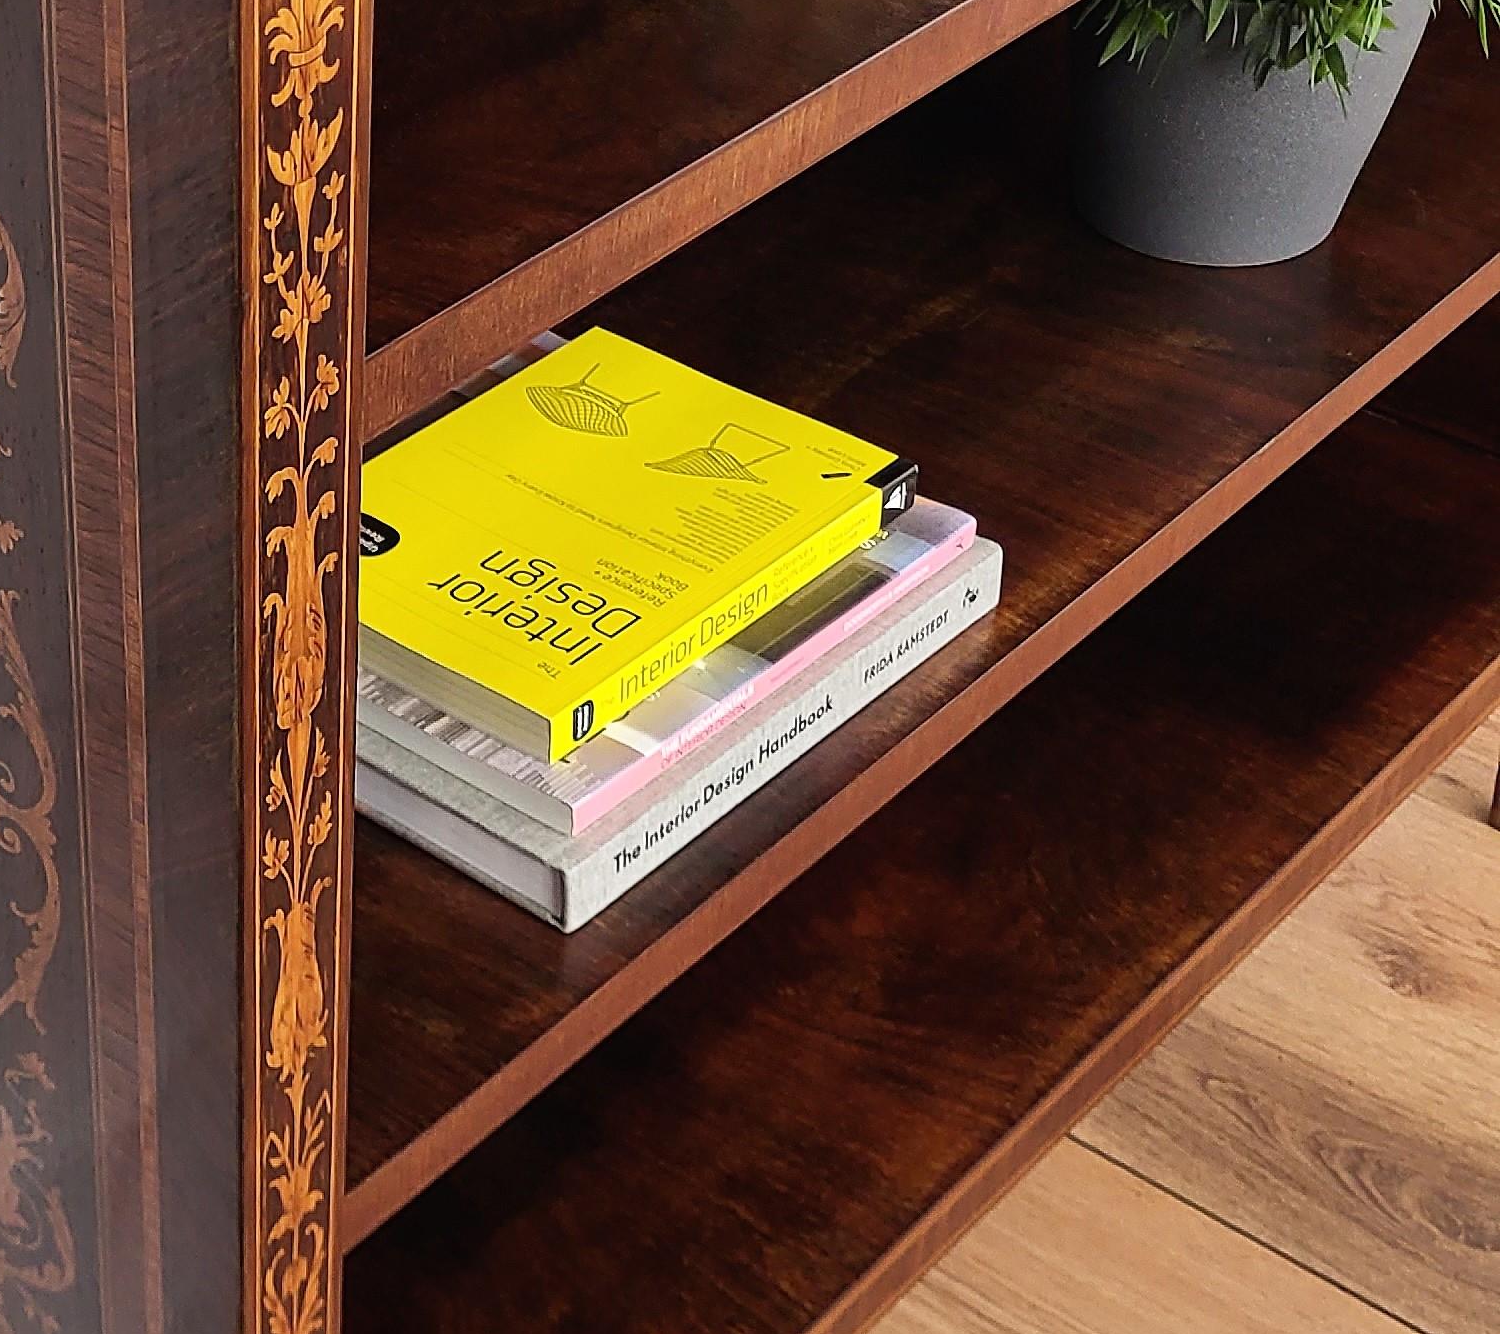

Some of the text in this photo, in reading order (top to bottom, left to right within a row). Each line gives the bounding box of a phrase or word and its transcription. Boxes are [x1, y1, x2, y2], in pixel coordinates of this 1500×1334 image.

[479, 550, 642, 639] Design
[597, 558, 677, 600] Specification
[603, 574, 666, 607] Reference
[657, 572, 690, 593] Book
[427, 574, 603, 666] Interior
[620, 633, 696, 704] Interior
[700, 584, 768, 647] Design
[863, 610, 949, 684] FRIDA RAMSTEDT
[614, 844, 641, 873] The
[645, 798, 701, 850] Interior
[703, 757, 754, 806] Design
[759, 694, 834, 764] Handbook
